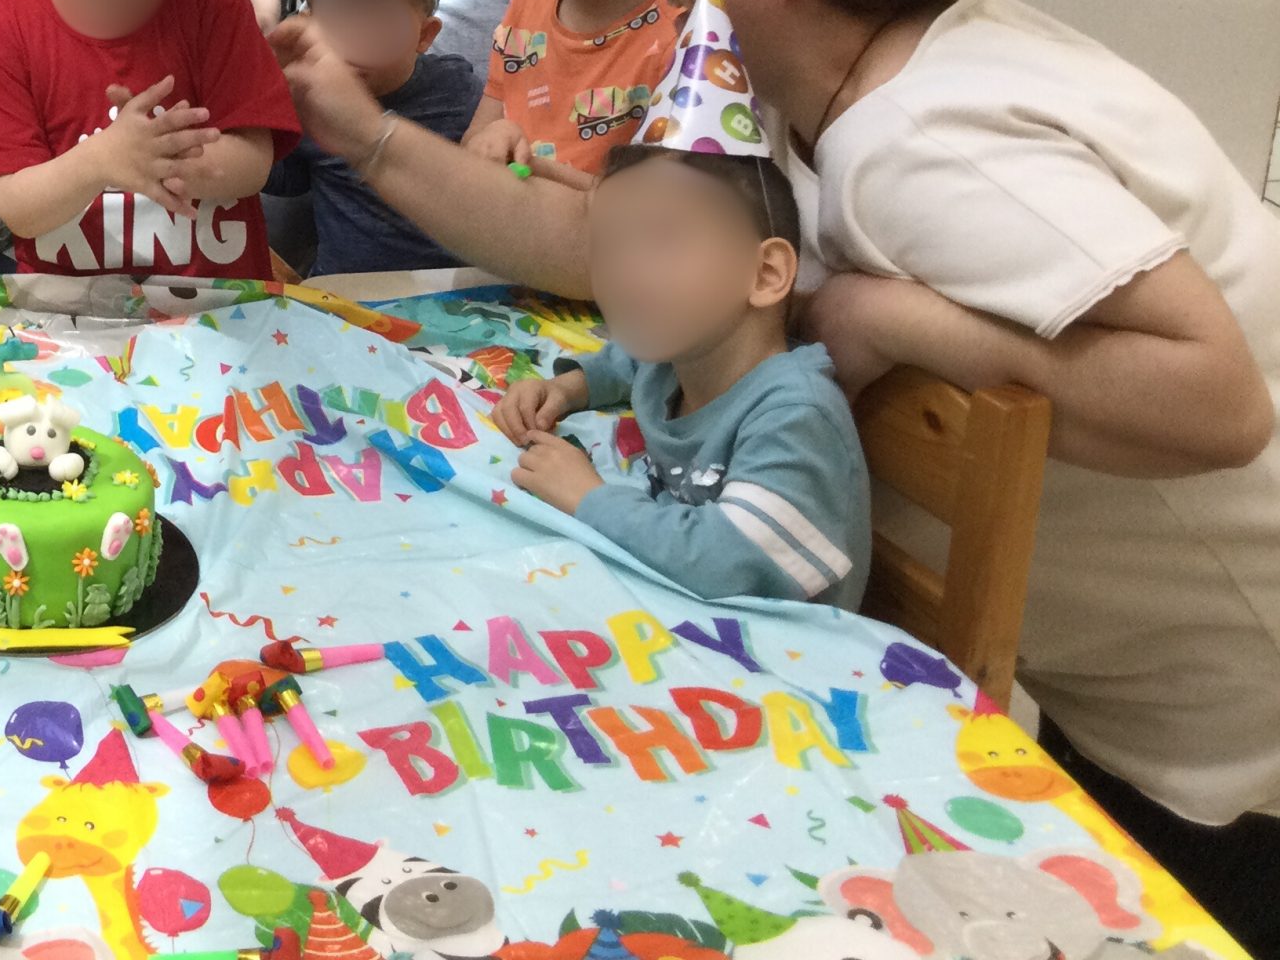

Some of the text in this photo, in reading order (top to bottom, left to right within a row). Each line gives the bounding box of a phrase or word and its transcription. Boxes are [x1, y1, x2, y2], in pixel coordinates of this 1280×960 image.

[35, 191, 247, 271] KING
[383, 609, 763, 701] HAPPY
[357, 683, 870, 796] BIRTHDAY
